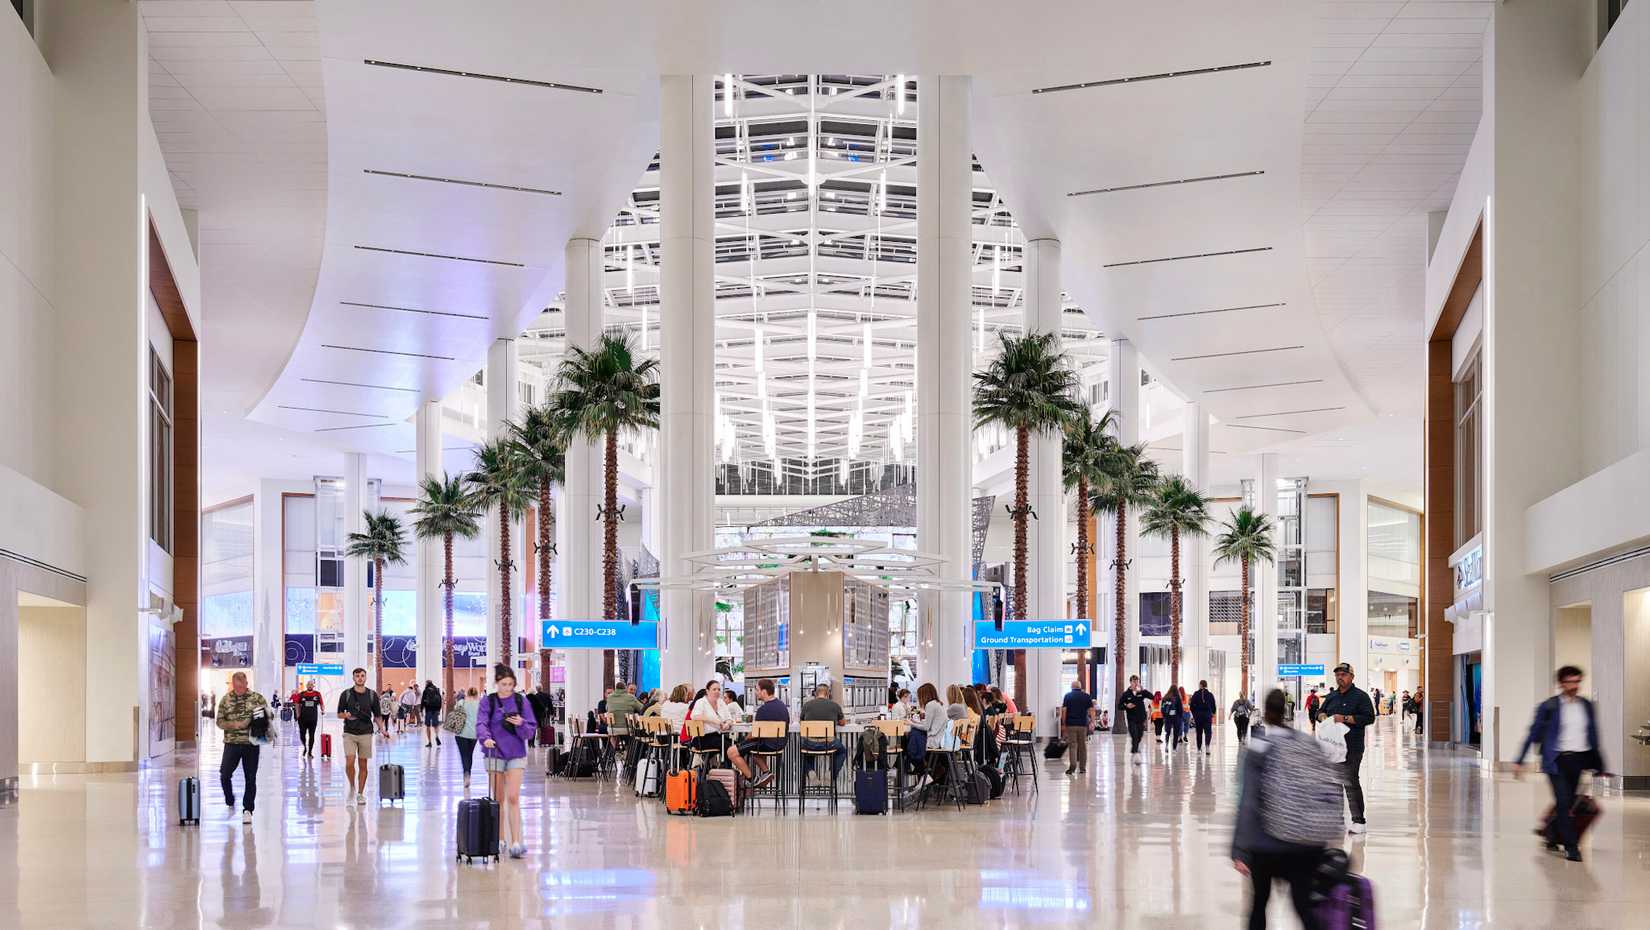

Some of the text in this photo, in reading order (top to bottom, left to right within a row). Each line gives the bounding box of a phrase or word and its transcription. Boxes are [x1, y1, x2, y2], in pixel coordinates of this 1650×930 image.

[574, 628, 616, 636] C230-C238
[1027, 626, 1064, 635] Bag Claim
[981, 636, 1064, 644] Ground Transportation
